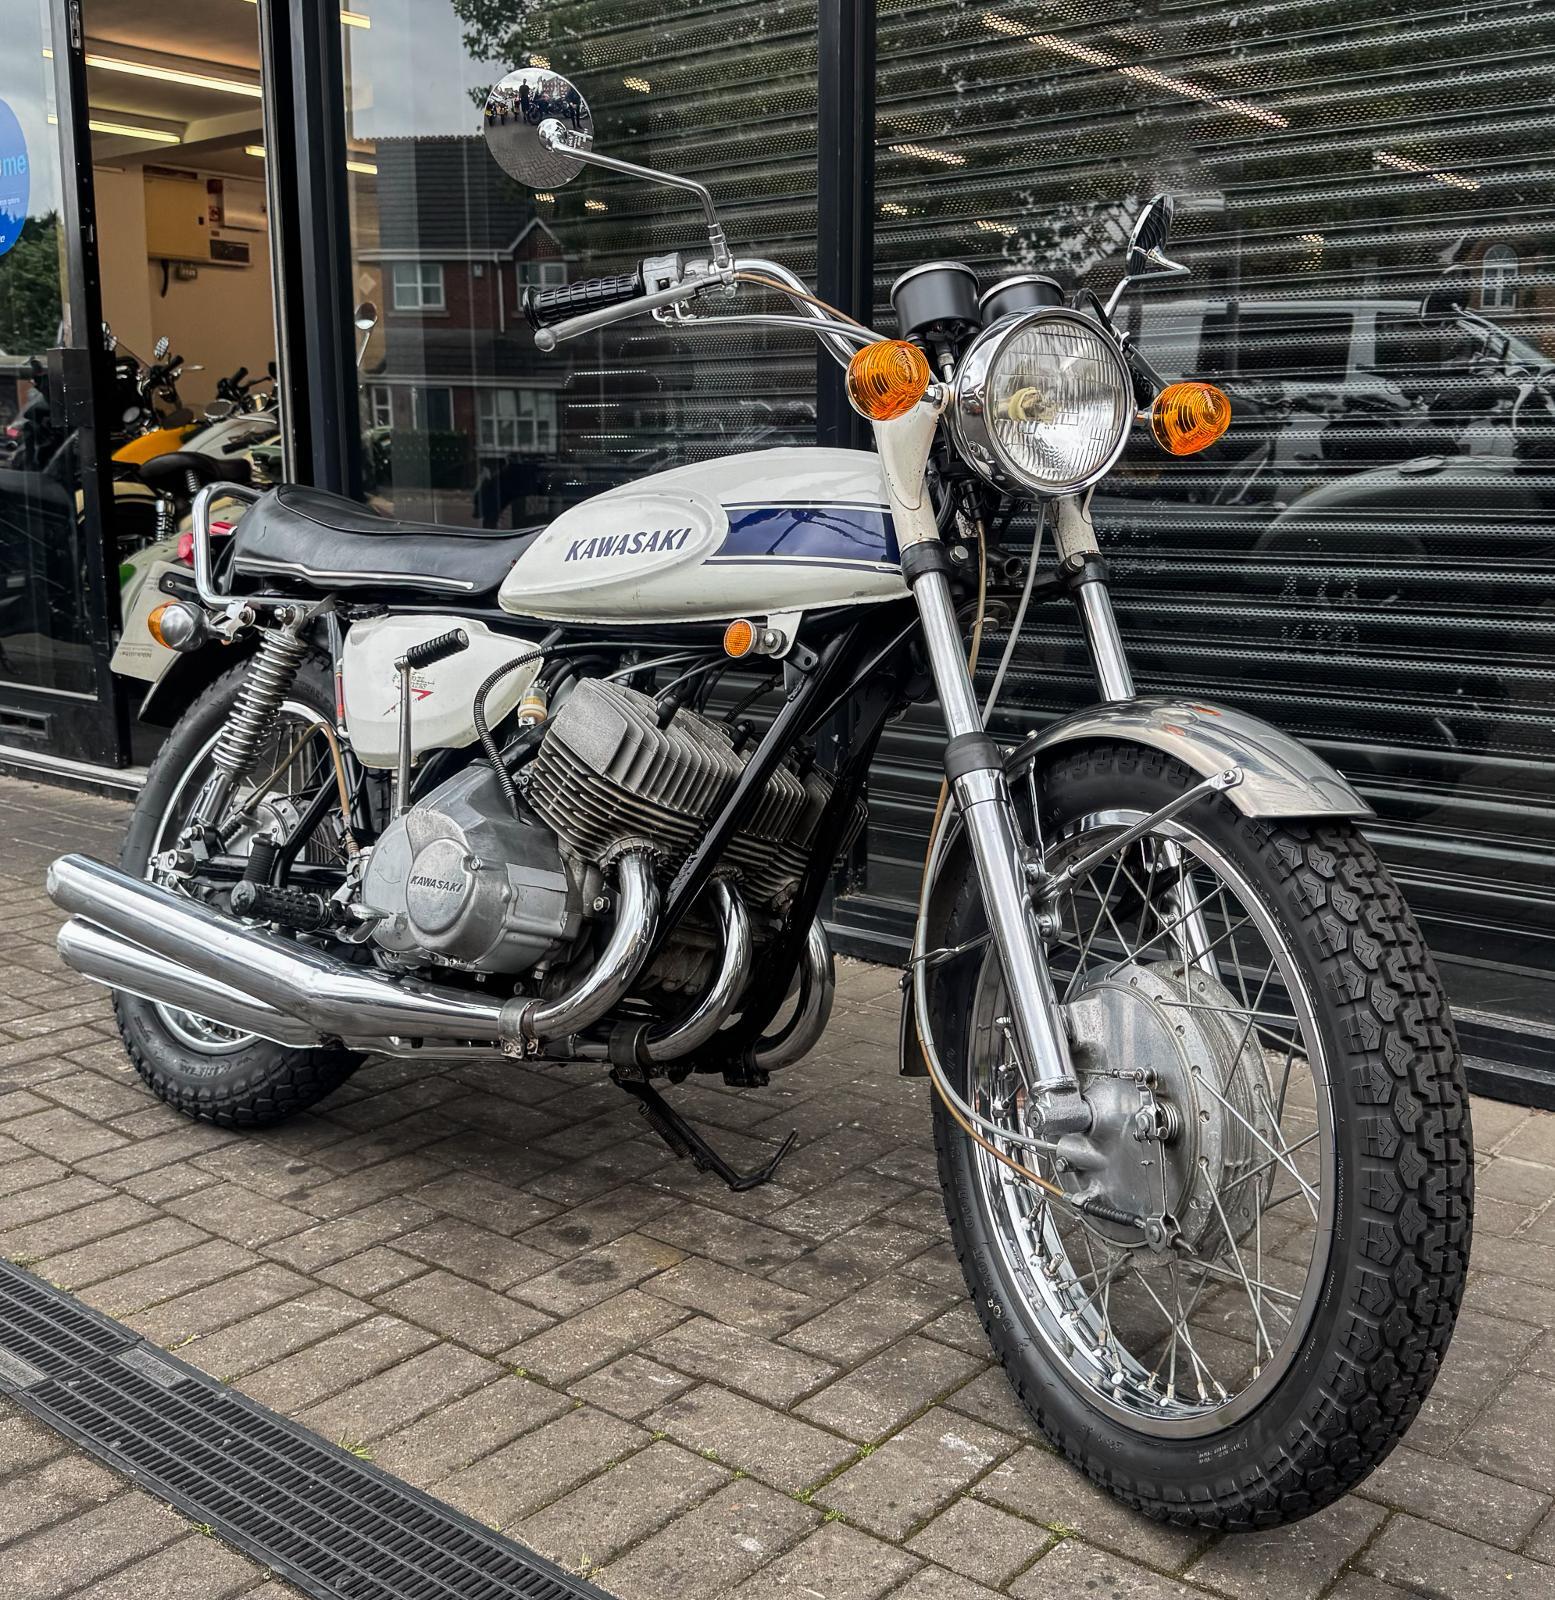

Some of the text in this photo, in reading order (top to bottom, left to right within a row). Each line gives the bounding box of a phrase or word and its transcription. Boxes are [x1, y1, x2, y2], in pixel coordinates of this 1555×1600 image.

[0, 154, 27, 177] me
[564, 527, 692, 562] KAWASAKI
[410, 875, 463, 893] KAWASAKI
